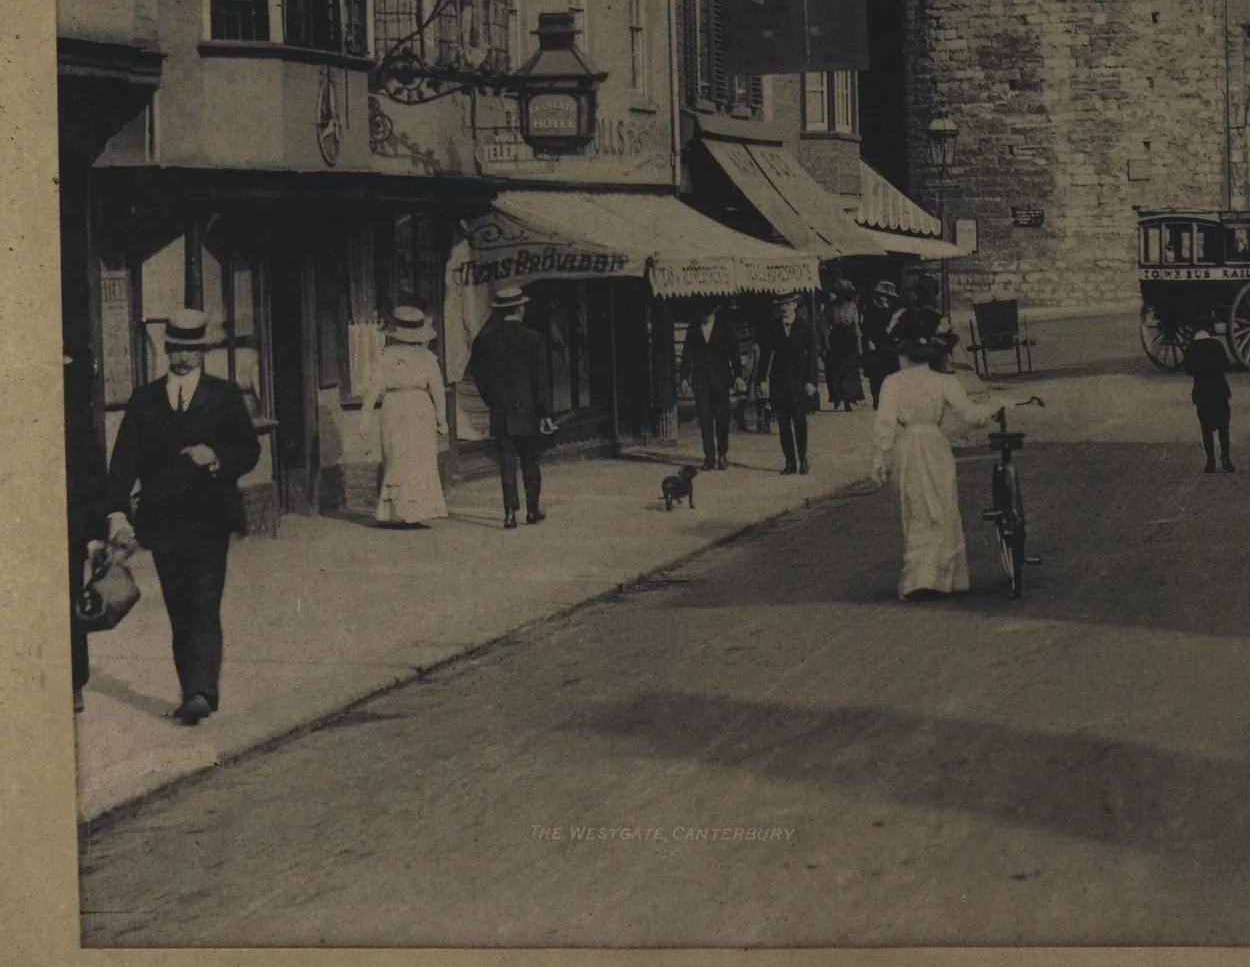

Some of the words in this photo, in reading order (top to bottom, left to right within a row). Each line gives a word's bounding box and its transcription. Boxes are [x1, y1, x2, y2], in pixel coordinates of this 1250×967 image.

[533, 118, 576, 129] HOTEL
[1144, 270, 1181, 279] TOWN
[1186, 269, 1210, 279] BUS
